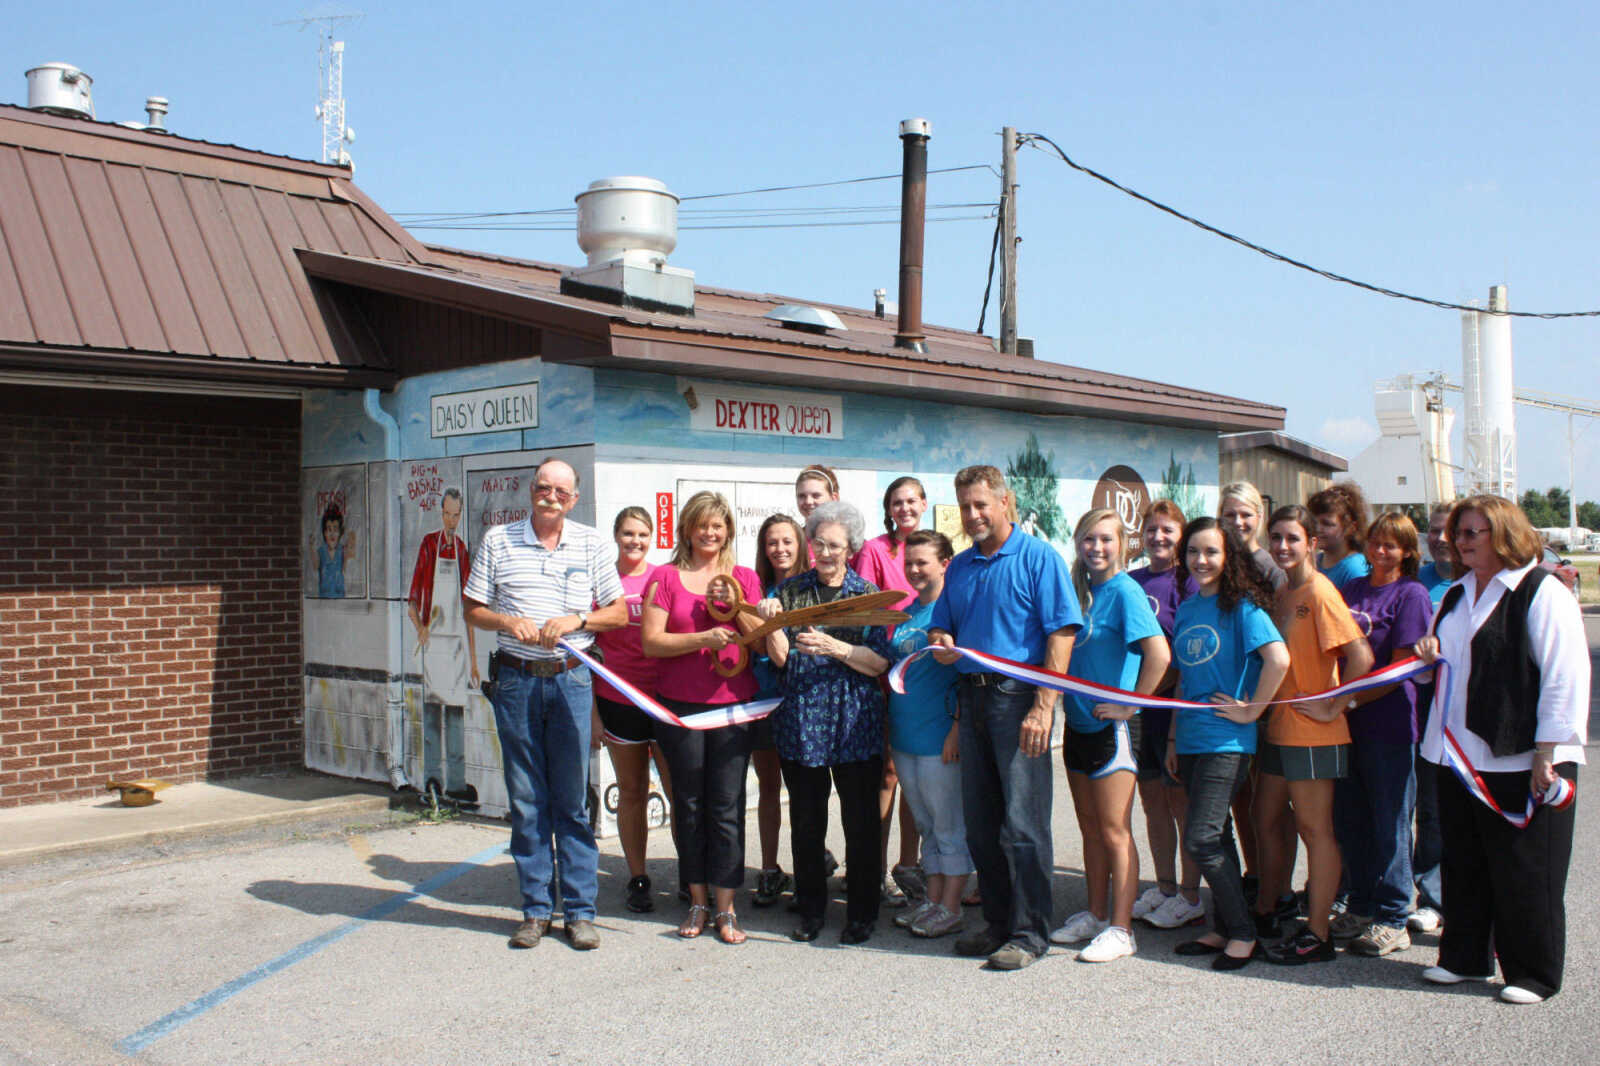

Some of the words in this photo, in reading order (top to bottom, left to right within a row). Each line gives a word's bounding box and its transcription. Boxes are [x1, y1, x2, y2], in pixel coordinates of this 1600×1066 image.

[436, 401, 476, 432] DAISY
[483, 395, 533, 428] QUEEN
[715, 399, 780, 431] DEXTER
[407, 479, 444, 500] BASKET
[482, 476, 519, 492] MALTS
[482, 509, 528, 526] CUSTARD
[659, 495, 668, 546] OPEN
